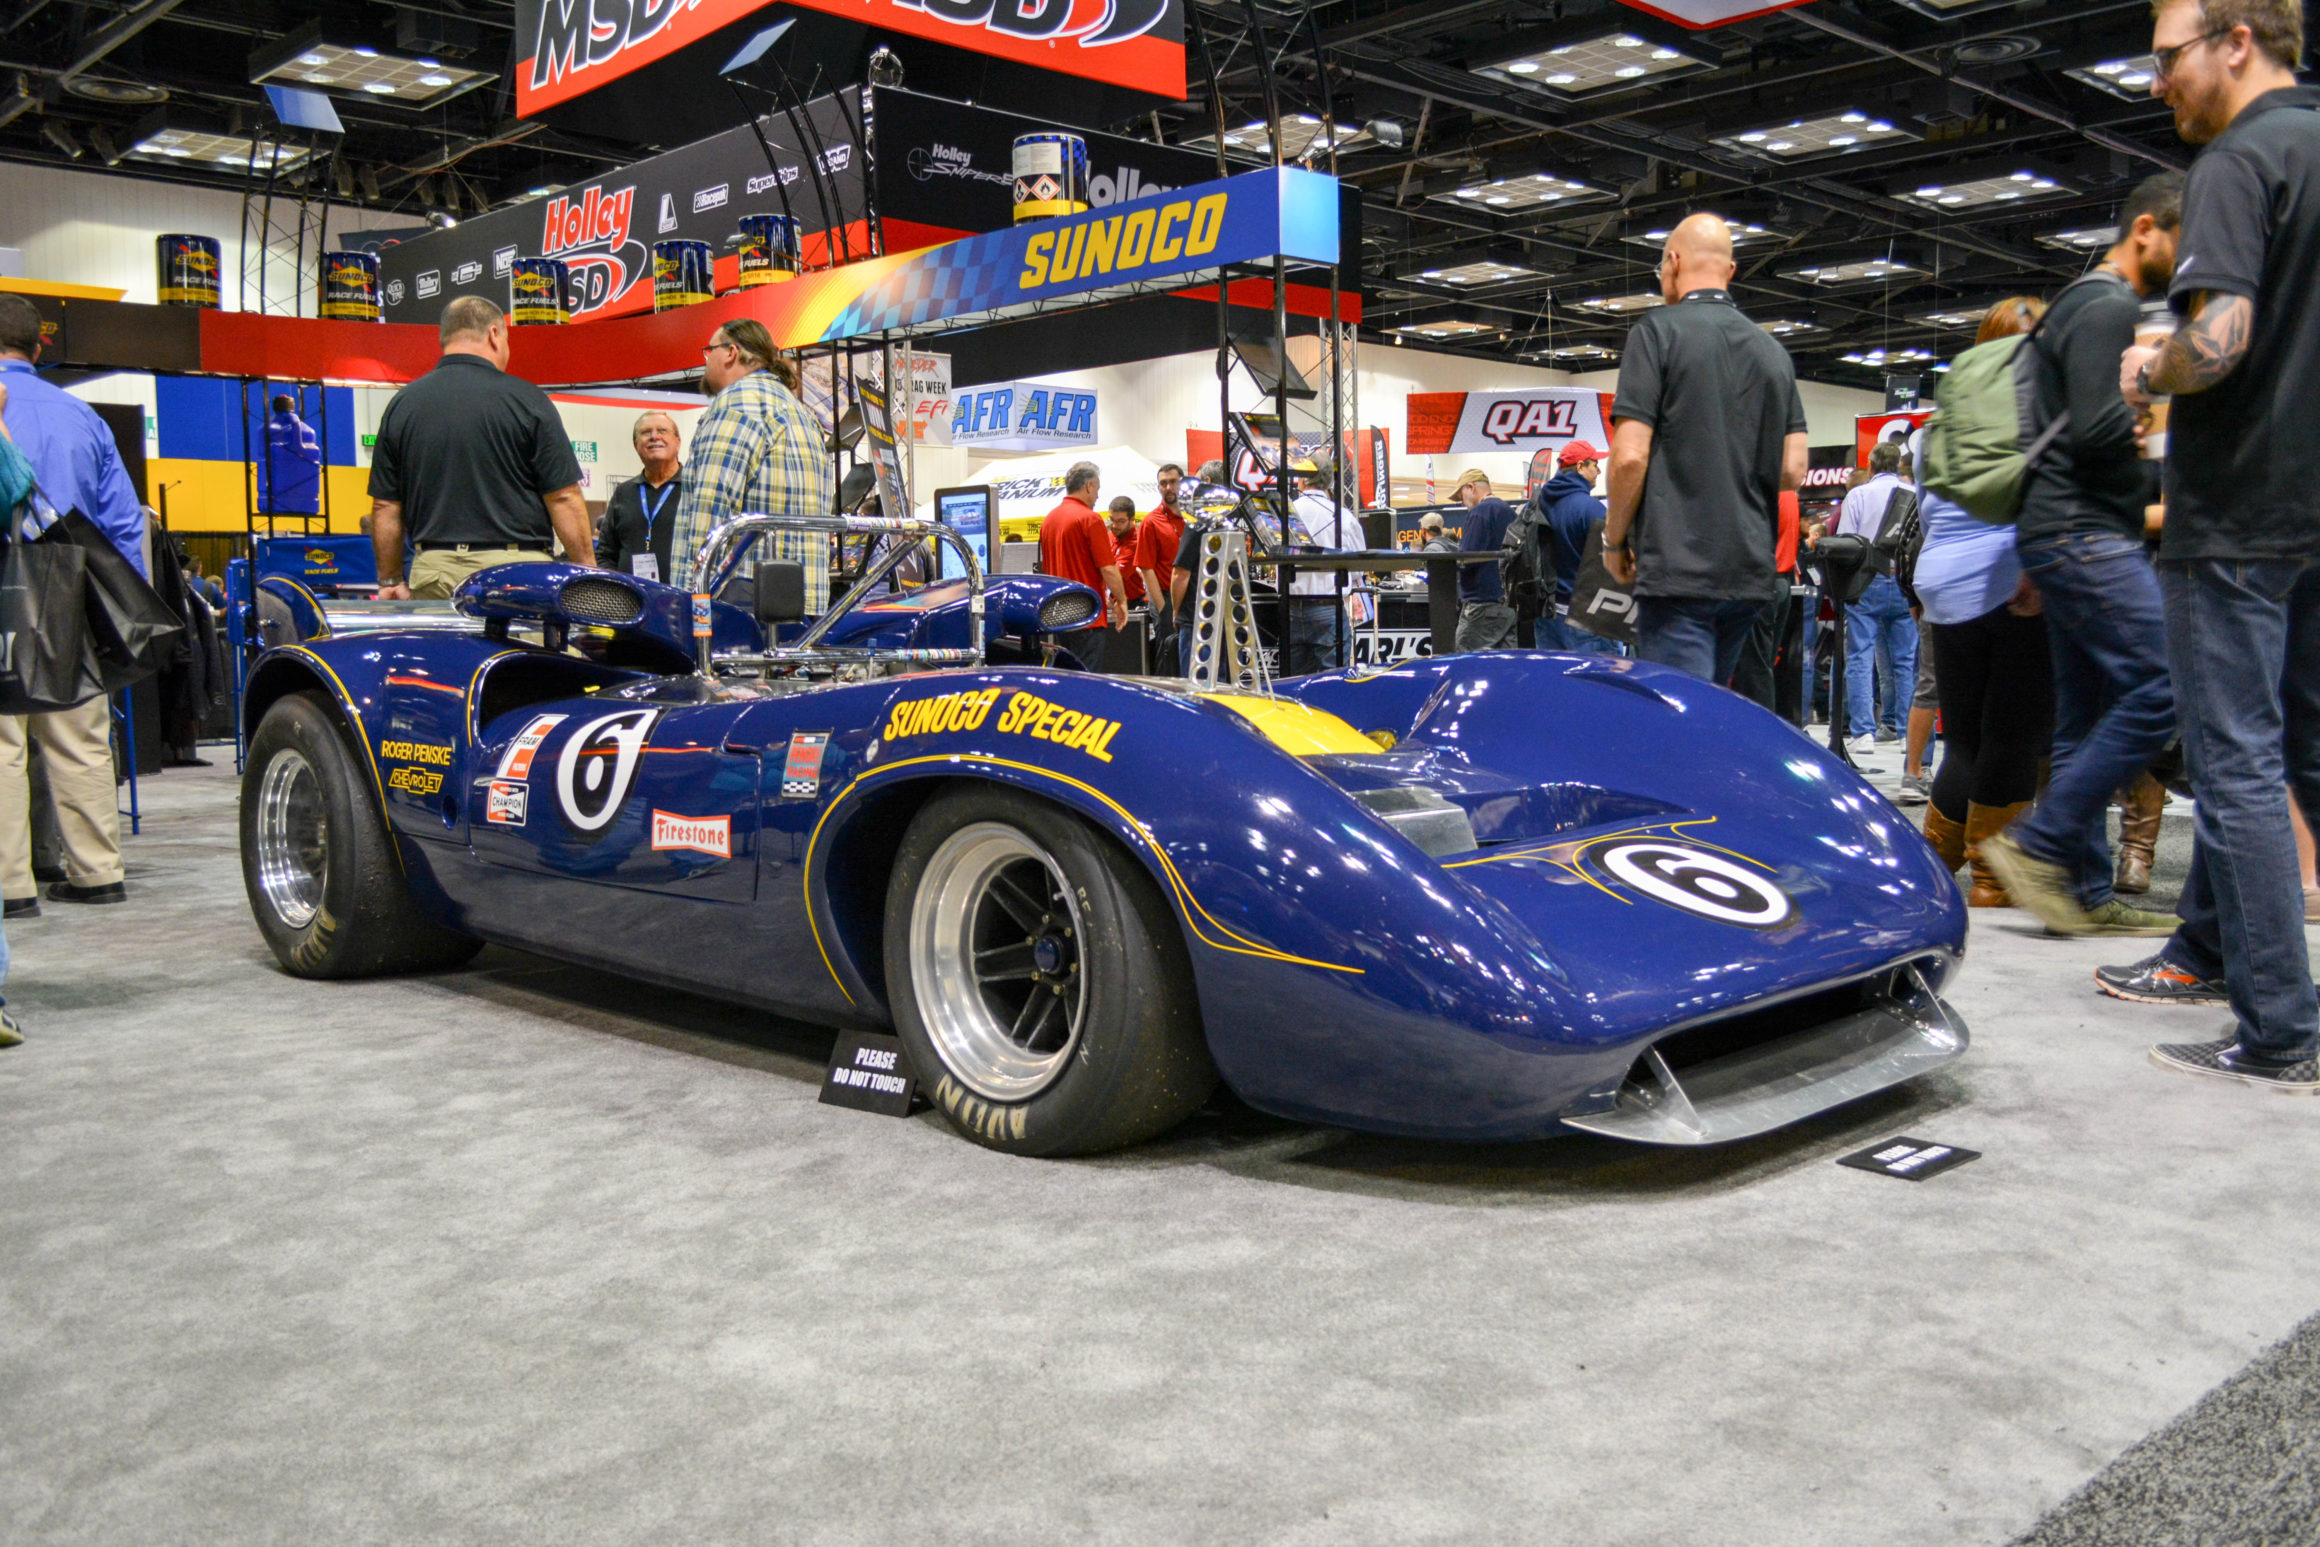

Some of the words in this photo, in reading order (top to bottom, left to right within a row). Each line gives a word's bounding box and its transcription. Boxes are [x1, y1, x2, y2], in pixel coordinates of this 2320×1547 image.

[932, 144, 971, 167] Holley
[542, 185, 634, 253] Holley
[1019, 193, 1227, 289] SUNOCO
[744, 258, 769, 268] FUELS
[174, 275, 202, 285] RACE
[328, 271, 374, 285] SUNOCO
[512, 277, 554, 288] SUNOCO
[568, 261, 612, 317] SD
[658, 281, 683, 291] FUELS
[327, 292, 352, 300] RACE
[530, 297, 559, 305] FUELS
[925, 381, 947, 395] WEEK
[951, 389, 1013, 434] AFR
[1020, 390, 1097, 433] AFR
[1483, 400, 1577, 444] QA1
[958, 431, 976, 440] Flow
[976, 428, 1010, 439] Research
[1031, 428, 1052, 437] Flow
[1053, 429, 1092, 439] Research
[574, 442, 593, 452] FIRE
[997, 477, 1045, 490] RICK
[1355, 637, 1432, 662] ARL'S
[883, 687, 1001, 741] SUNOCO
[997, 691, 1122, 763] SPECIAL
[381, 740, 413, 760] ROGER
[413, 743, 452, 765] PENSKE
[393, 770, 441, 790] CHEVROLET
[557, 709, 659, 830] 6
[492, 796, 522, 809] CHAMPION
[656, 818, 725, 845] Firestone
[1604, 844, 1789, 924] 6
[855, 1047, 897, 1070] PLEASE
[832, 1067, 849, 1084] DO
[849, 1070, 874, 1088] NOT
[870, 1073, 907, 1094] TOUCH
